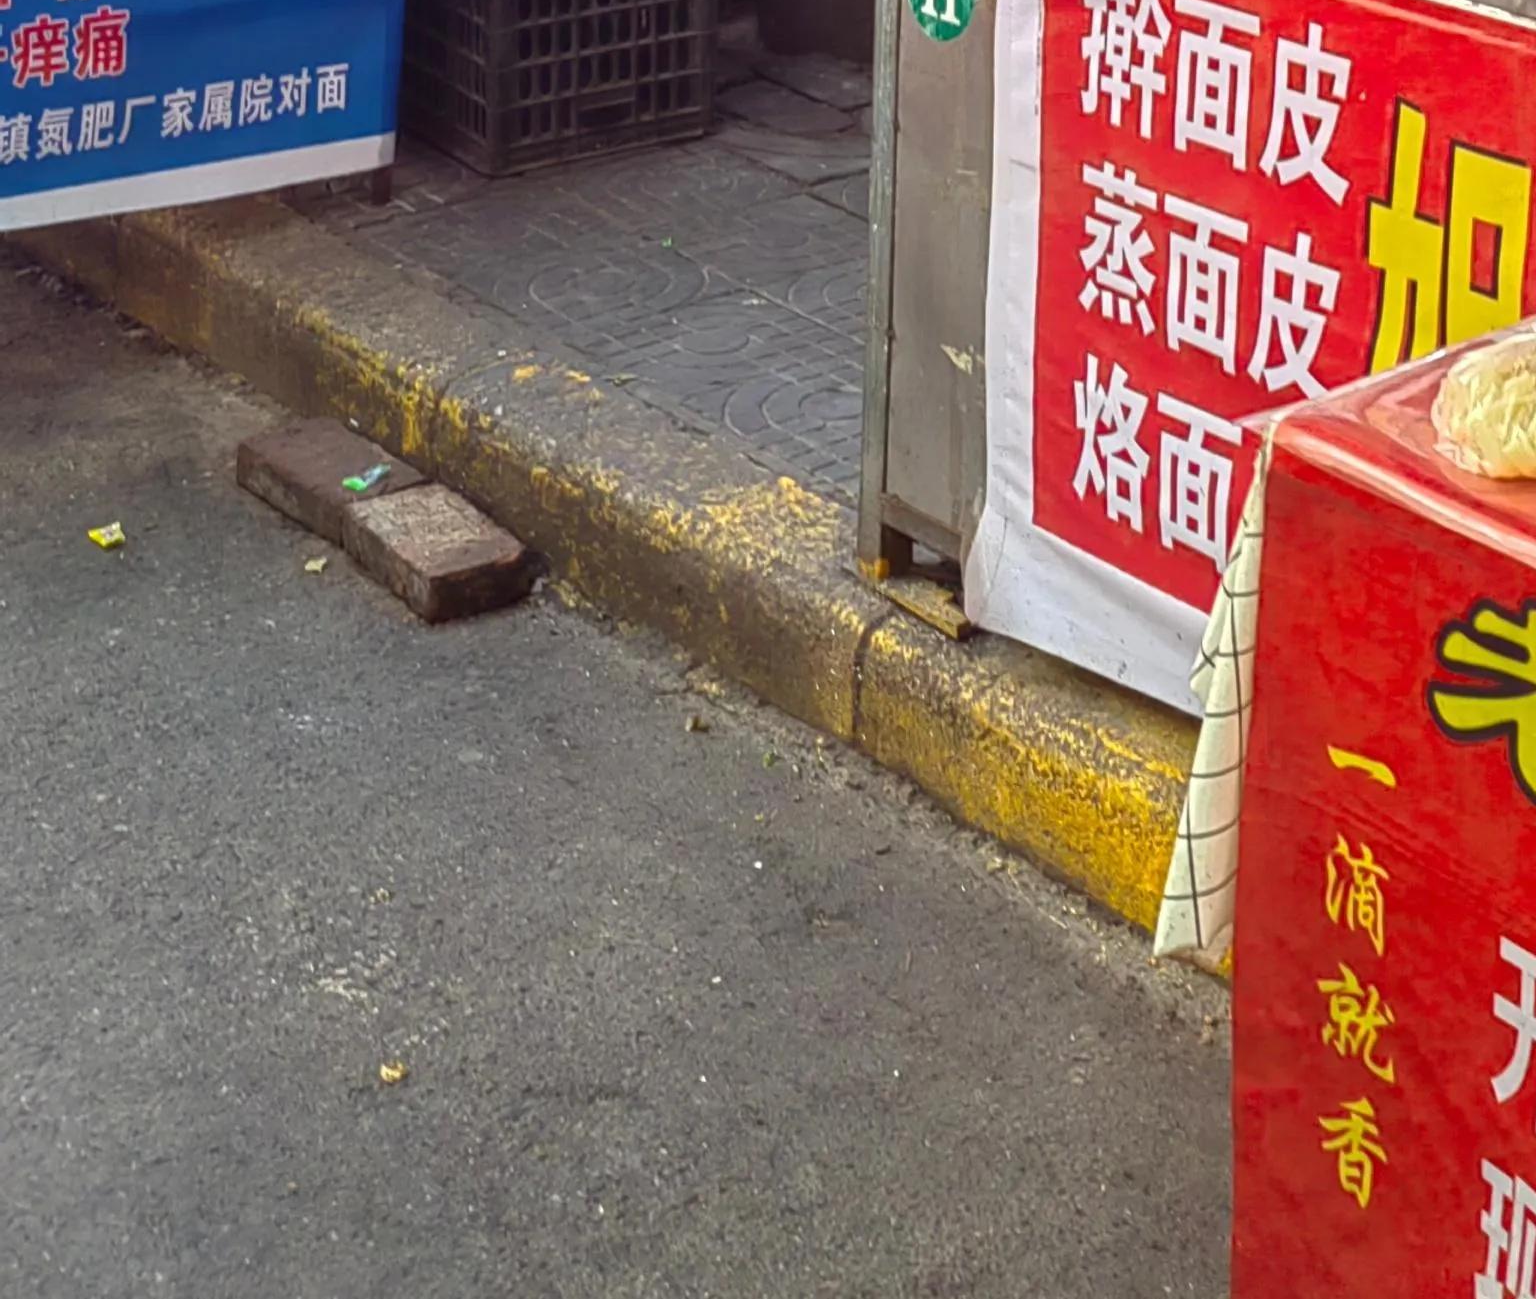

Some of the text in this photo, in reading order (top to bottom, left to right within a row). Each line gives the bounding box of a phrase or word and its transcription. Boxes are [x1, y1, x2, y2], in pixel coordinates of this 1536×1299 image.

[0, 5, 131, 89] 痒痛
[1077, 159, 1343, 400] 蒸面皮
[1316, 743, 1397, 1209] 一滴就香
